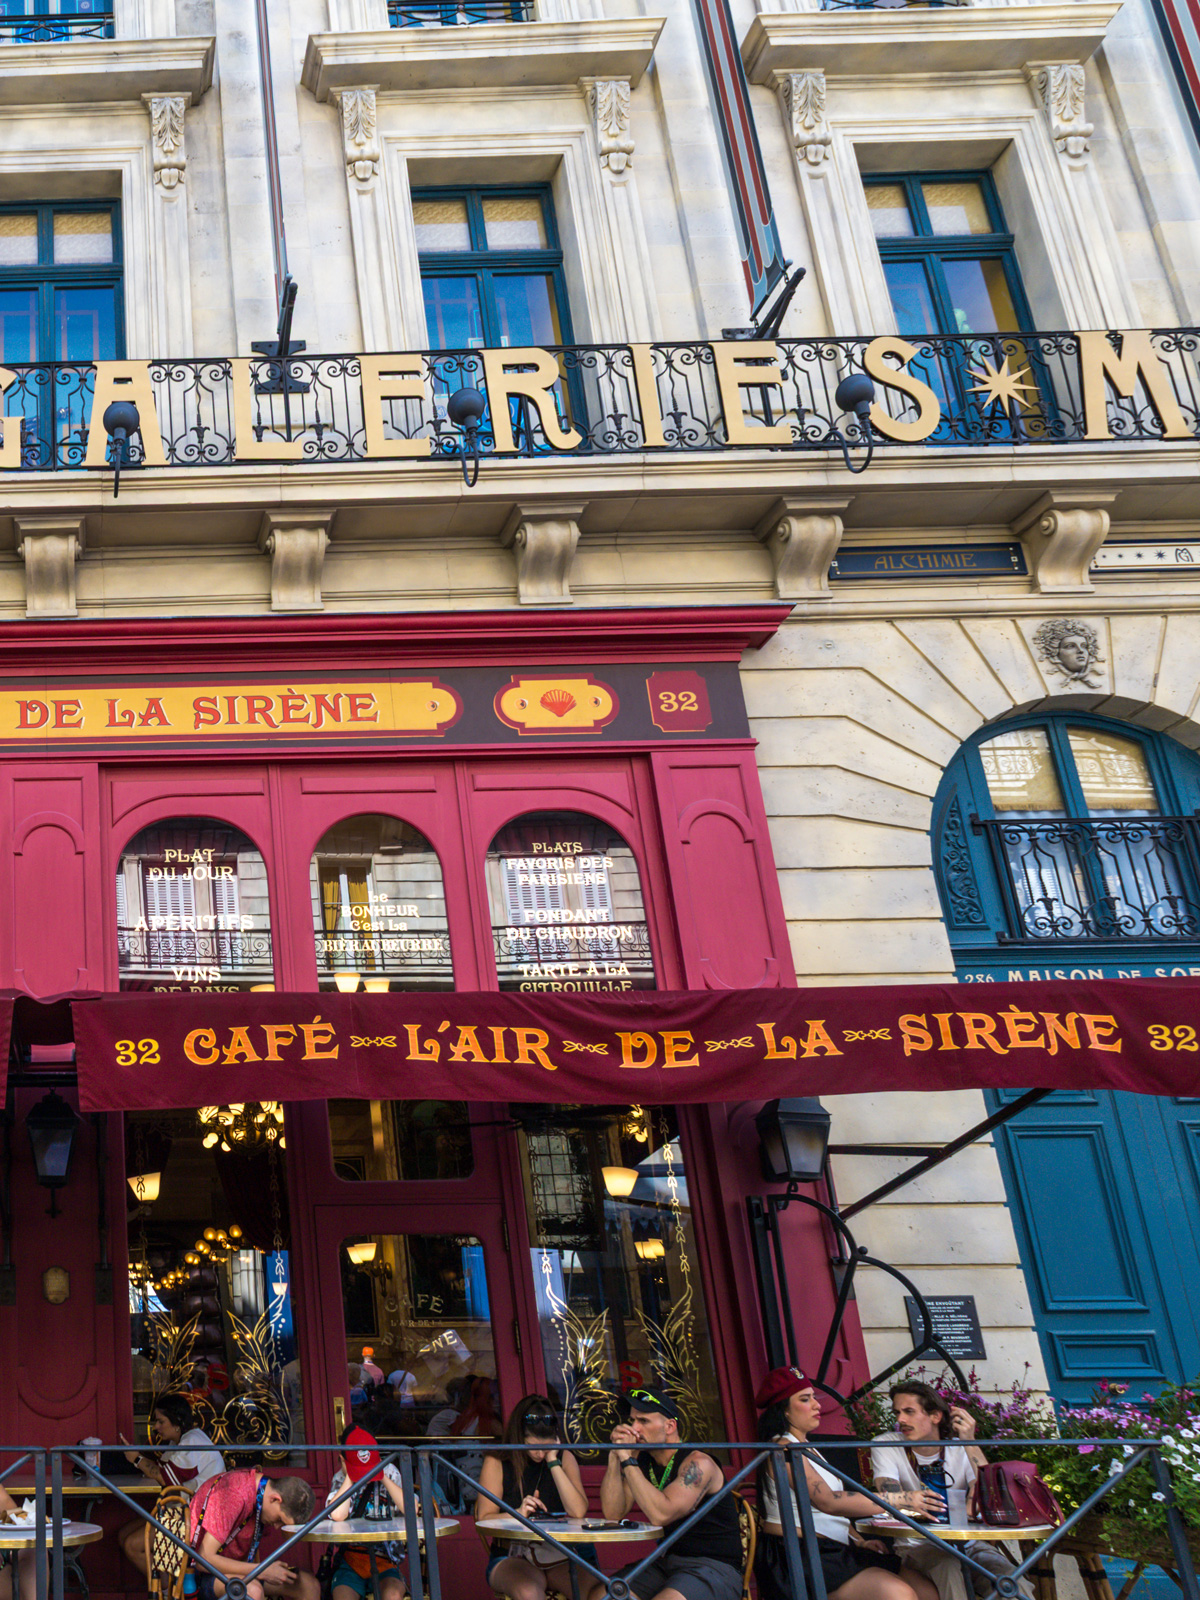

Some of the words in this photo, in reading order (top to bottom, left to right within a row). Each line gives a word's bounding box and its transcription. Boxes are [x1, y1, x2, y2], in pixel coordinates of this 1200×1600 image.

[874, 553, 977, 570] ALCHIMIE
[16, 699, 84, 731] DE
[103, 698, 180, 729] LA
[193, 688, 380, 731] SIRÈNE
[658, 691, 699, 713] 32
[164, 848, 215, 863] PLAT
[532, 842, 583, 854] PLATS
[507, 857, 575, 870] FAVORIS
[579, 857, 614, 869] DES
[148, 867, 176, 881] DU
[182, 866, 235, 881] JOUR
[518, 872, 607, 887] PARISIENS
[368, 891, 388, 903] Le
[340, 904, 420, 919] BONHEUR
[523, 909, 609, 924] FONDANT
[134, 913, 254, 933] APÉRITIFS
[349, 919, 385, 932] C'est
[388, 919, 408, 931] La
[505, 927, 531, 941] DU
[535, 925, 633, 941] CHAUDRON
[172, 966, 222, 984] VINS
[518, 962, 581, 979] TARTE
[586, 961, 599, 976] À
[604, 962, 630, 976] LA
[1008, 969, 1104, 982] MAISON
[519, 981, 634, 992] CITROUILLE
[115, 1039, 161, 1067] 32
[183, 1015, 340, 1066] CAFÉ
[403, 1020, 558, 1071] L'AIR
[615, 1031, 700, 1069] DE
[757, 1020, 844, 1060] LA
[898, 1004, 1123, 1056] SIRÈNE
[1147, 1024, 1199, 1052] 32
